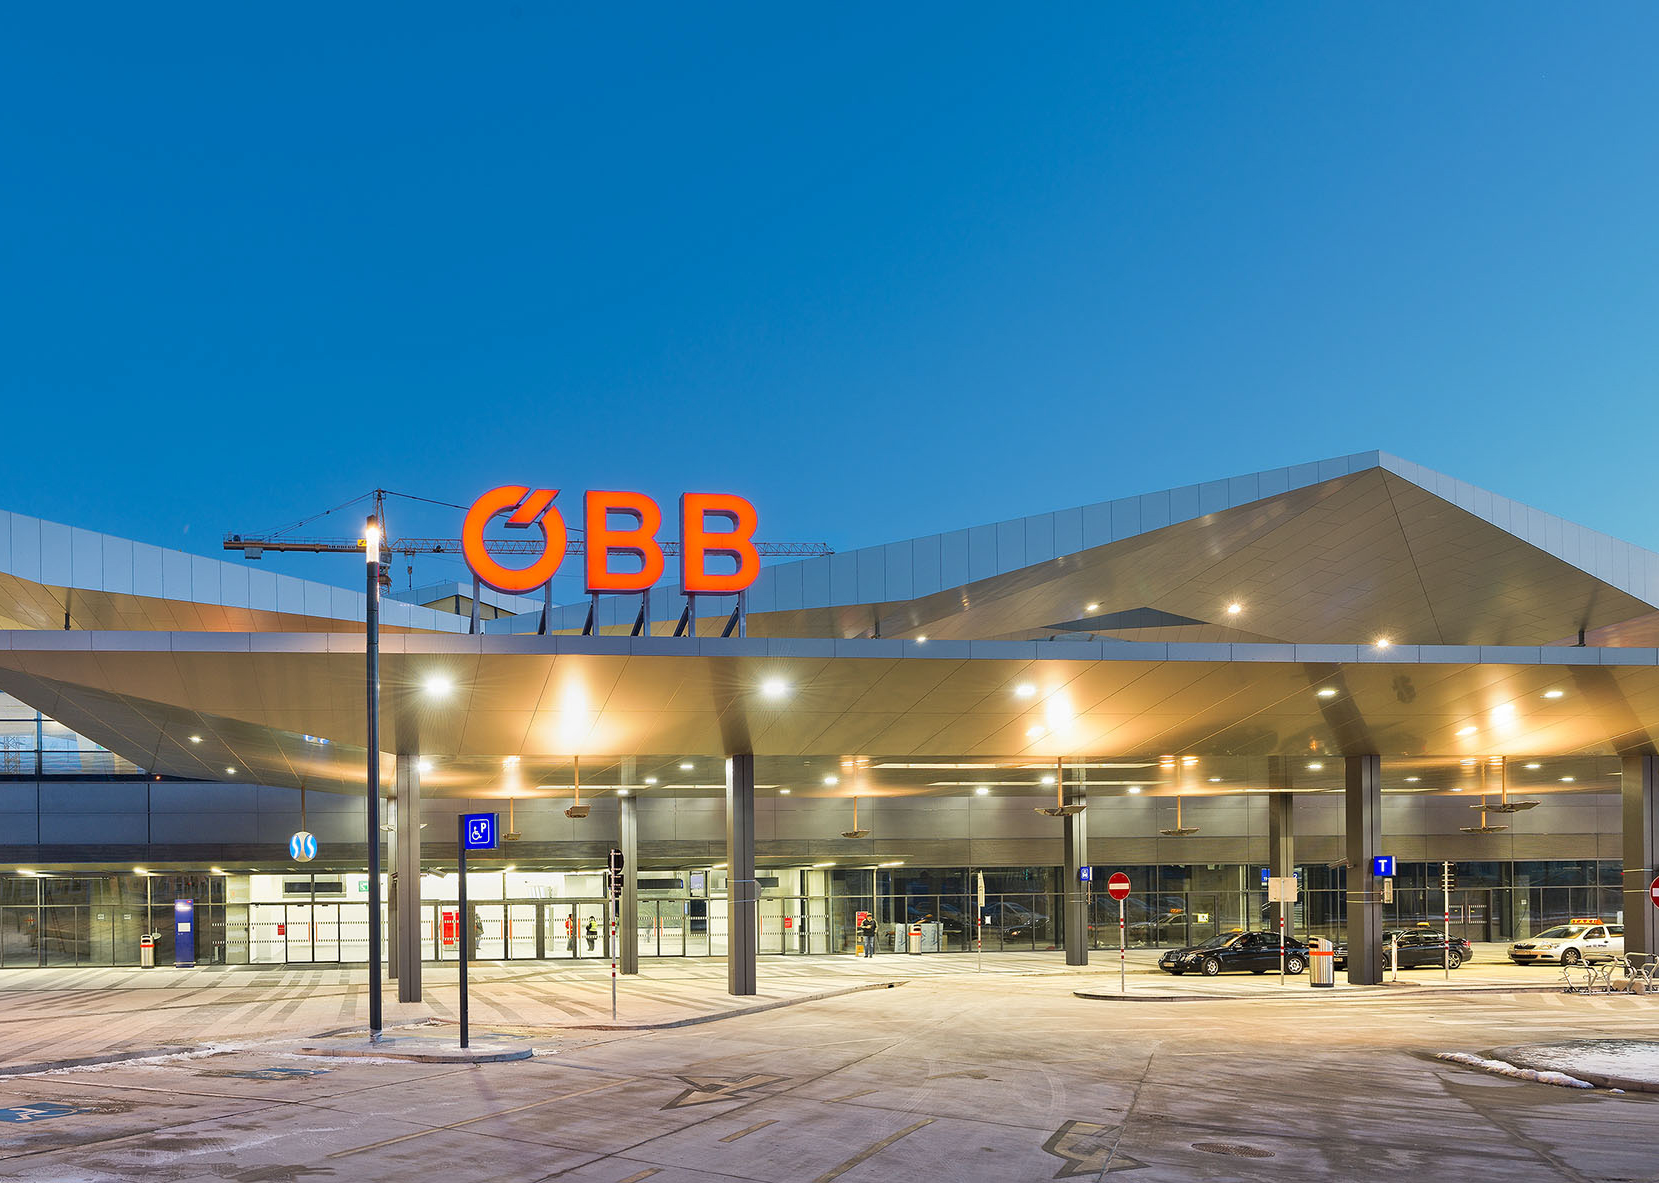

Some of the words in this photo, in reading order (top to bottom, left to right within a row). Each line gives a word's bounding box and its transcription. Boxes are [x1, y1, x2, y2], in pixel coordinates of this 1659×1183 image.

[462, 484, 761, 595] ÖBB
[480, 822, 487, 833] P
[1378, 859, 1388, 873] T
